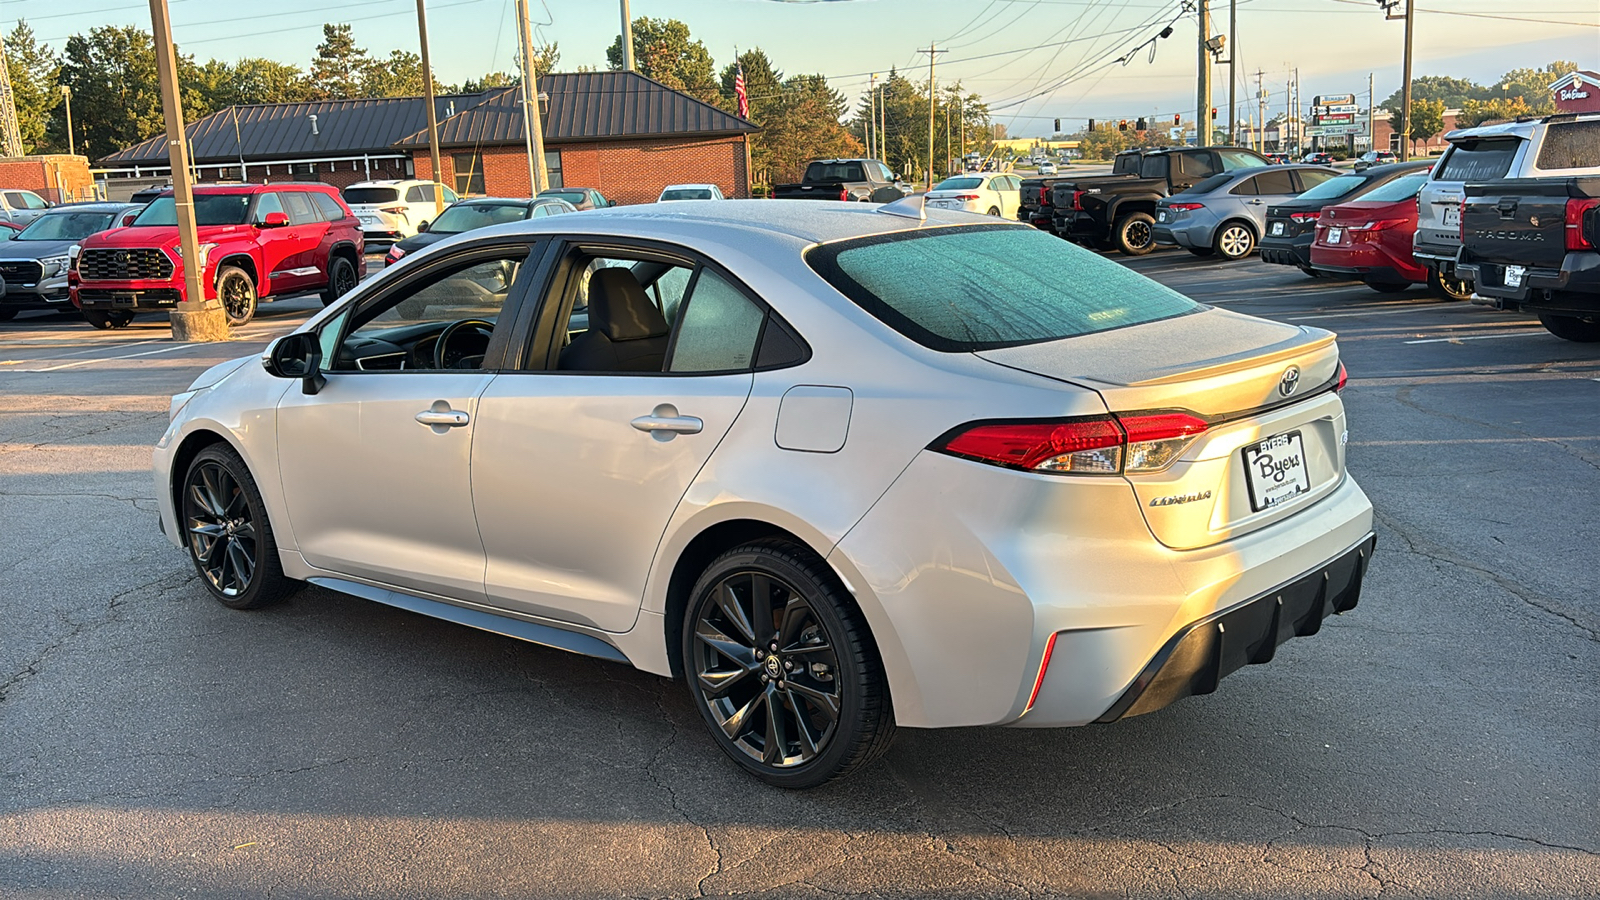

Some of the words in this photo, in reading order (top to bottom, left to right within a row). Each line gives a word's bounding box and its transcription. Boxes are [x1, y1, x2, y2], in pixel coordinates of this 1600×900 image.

[1560, 90, 1572, 101] Bob
[1572, 89, 1588, 100] Evans
[1476, 230, 1545, 242] TACOMA
[1260, 434, 1289, 453] BYERS
[1252, 453, 1300, 482] Byers
